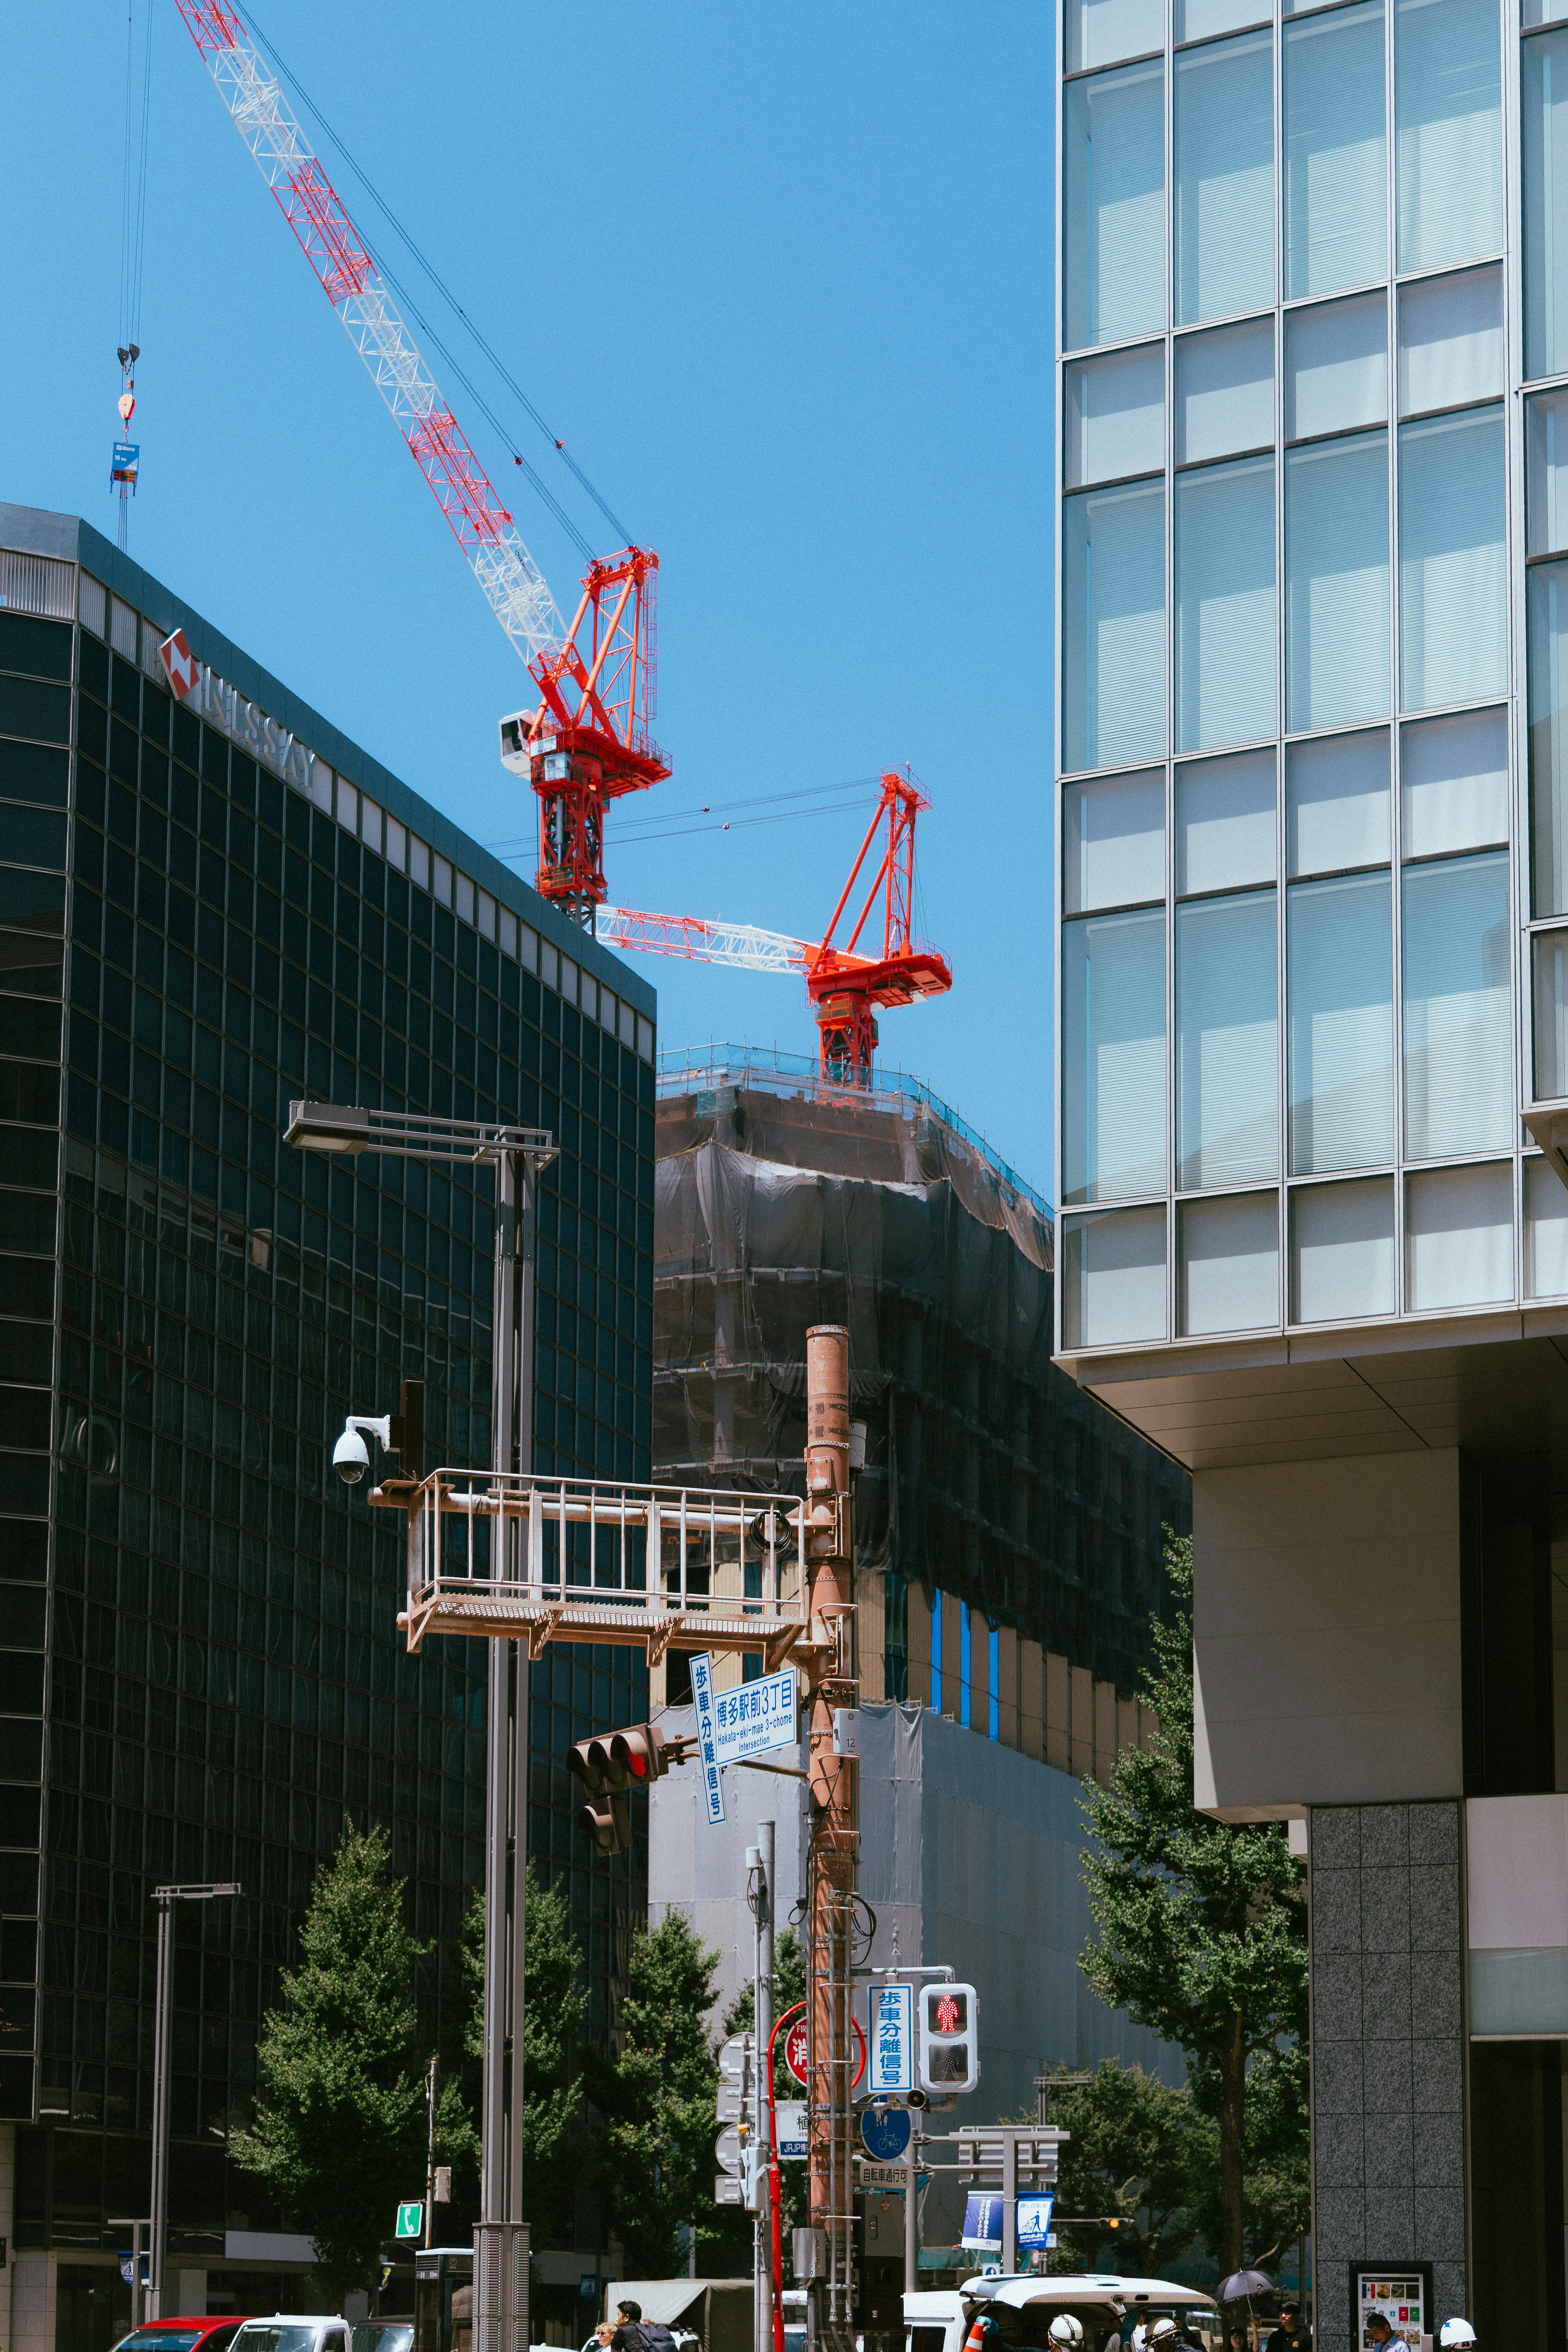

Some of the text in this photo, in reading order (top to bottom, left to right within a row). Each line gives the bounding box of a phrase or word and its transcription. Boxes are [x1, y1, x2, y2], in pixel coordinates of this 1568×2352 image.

[205, 666, 317, 789] NISSAY
[717, 1679, 791, 1729] 博多駅前3丁目
[696, 1665, 720, 1815] 歩車分離信号
[718, 1714, 792, 1746] Hakata-eki-mae 3-chome
[739, 1736, 770, 1752] Intersection
[846, 1738, 855, 1747] 12
[879, 1991, 902, 2084] 歩車分離信号
[863, 2167, 908, 2183] 自転車通行可
